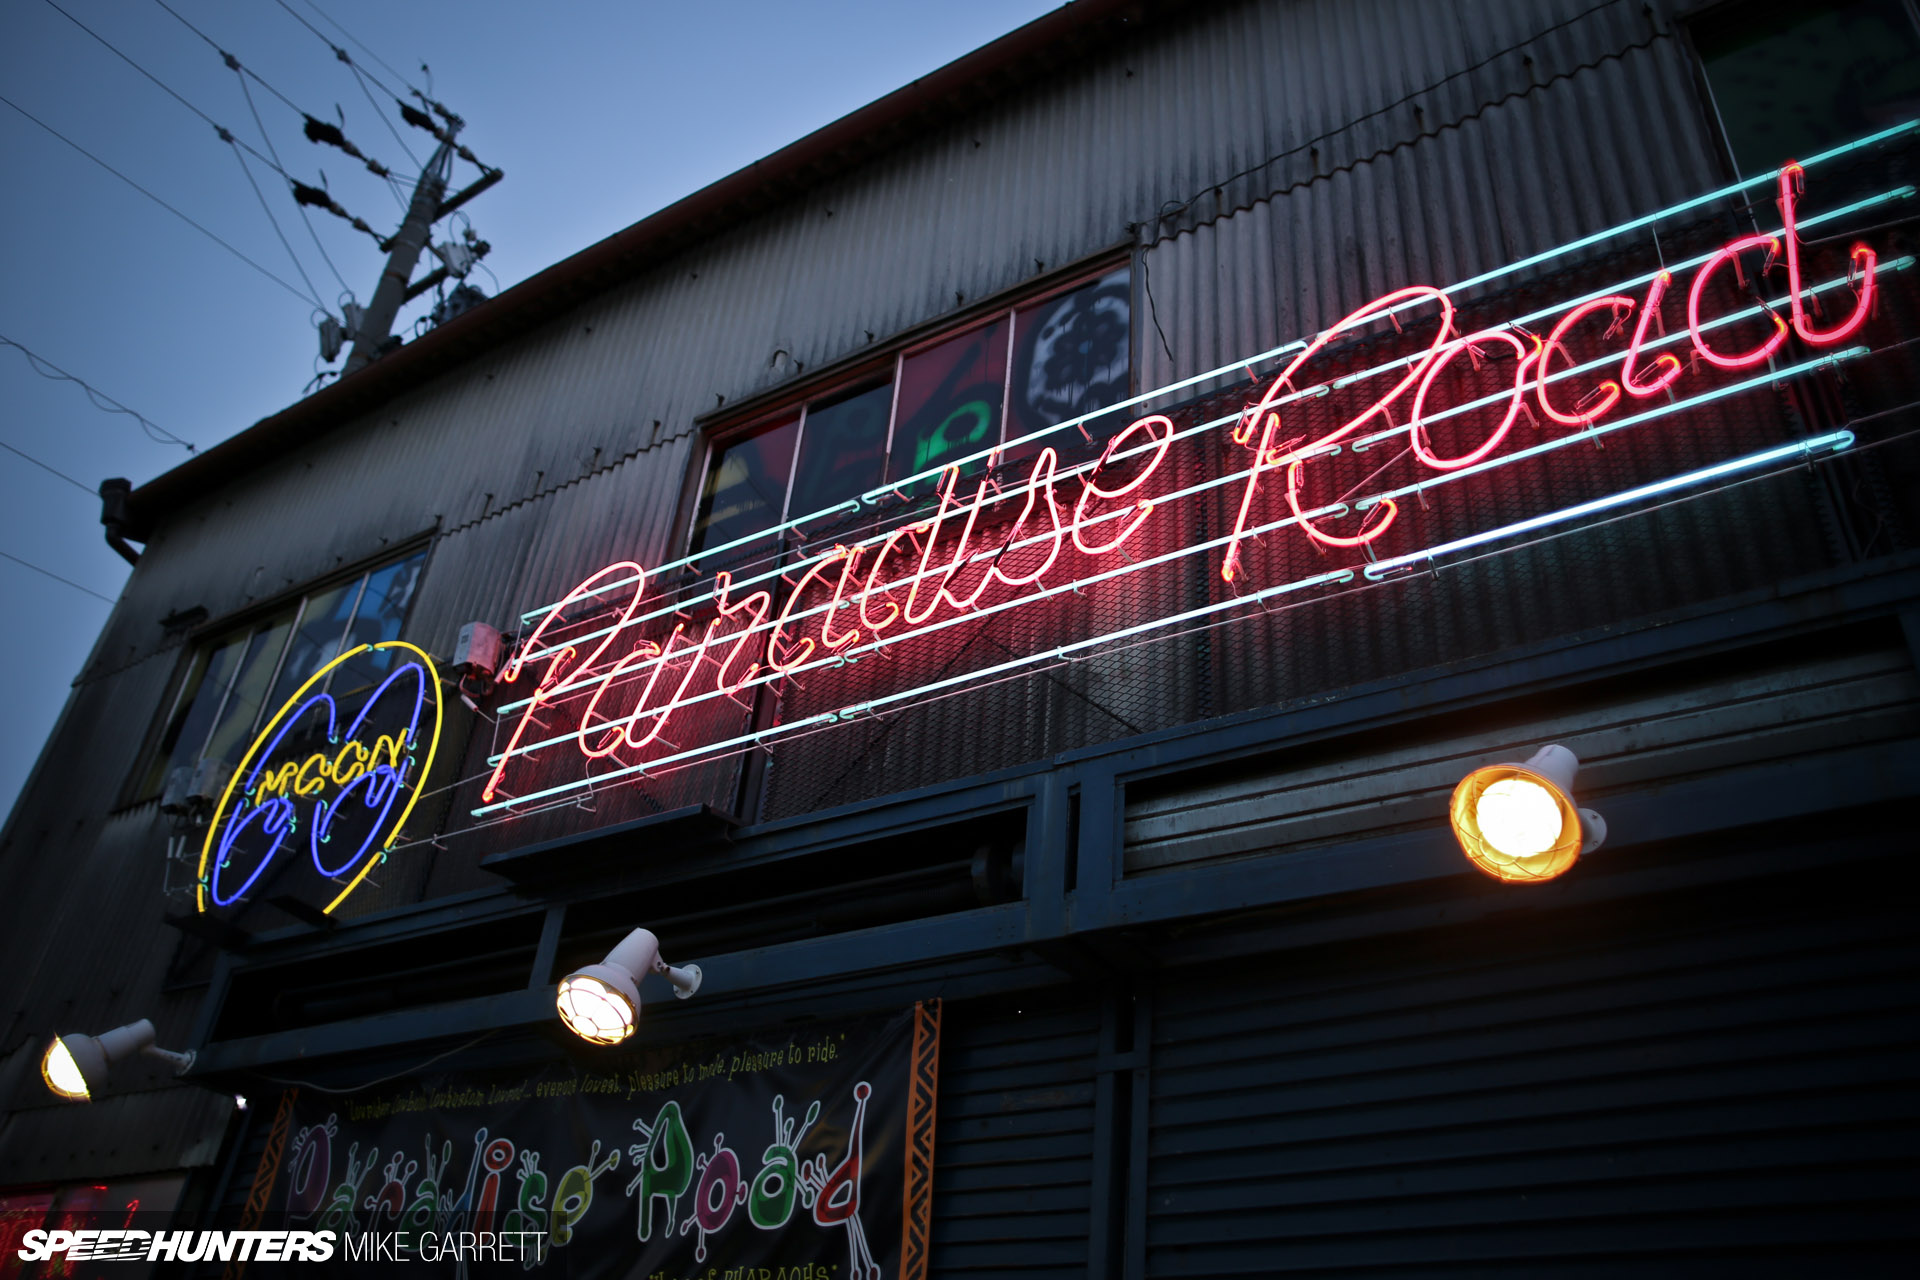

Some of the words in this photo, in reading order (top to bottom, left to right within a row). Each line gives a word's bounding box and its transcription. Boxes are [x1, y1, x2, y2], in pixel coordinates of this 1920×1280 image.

[482, 414, 1175, 803] Paradise
[1221, 158, 1879, 582] Road
[255, 727, 409, 807] MOON
[625, 1068, 679, 1101] pleasure
[682, 1061, 695, 1084] to
[727, 1048, 785, 1083] pleasure
[788, 1041, 802, 1064] to
[286, 1112, 620, 1271] Paradise
